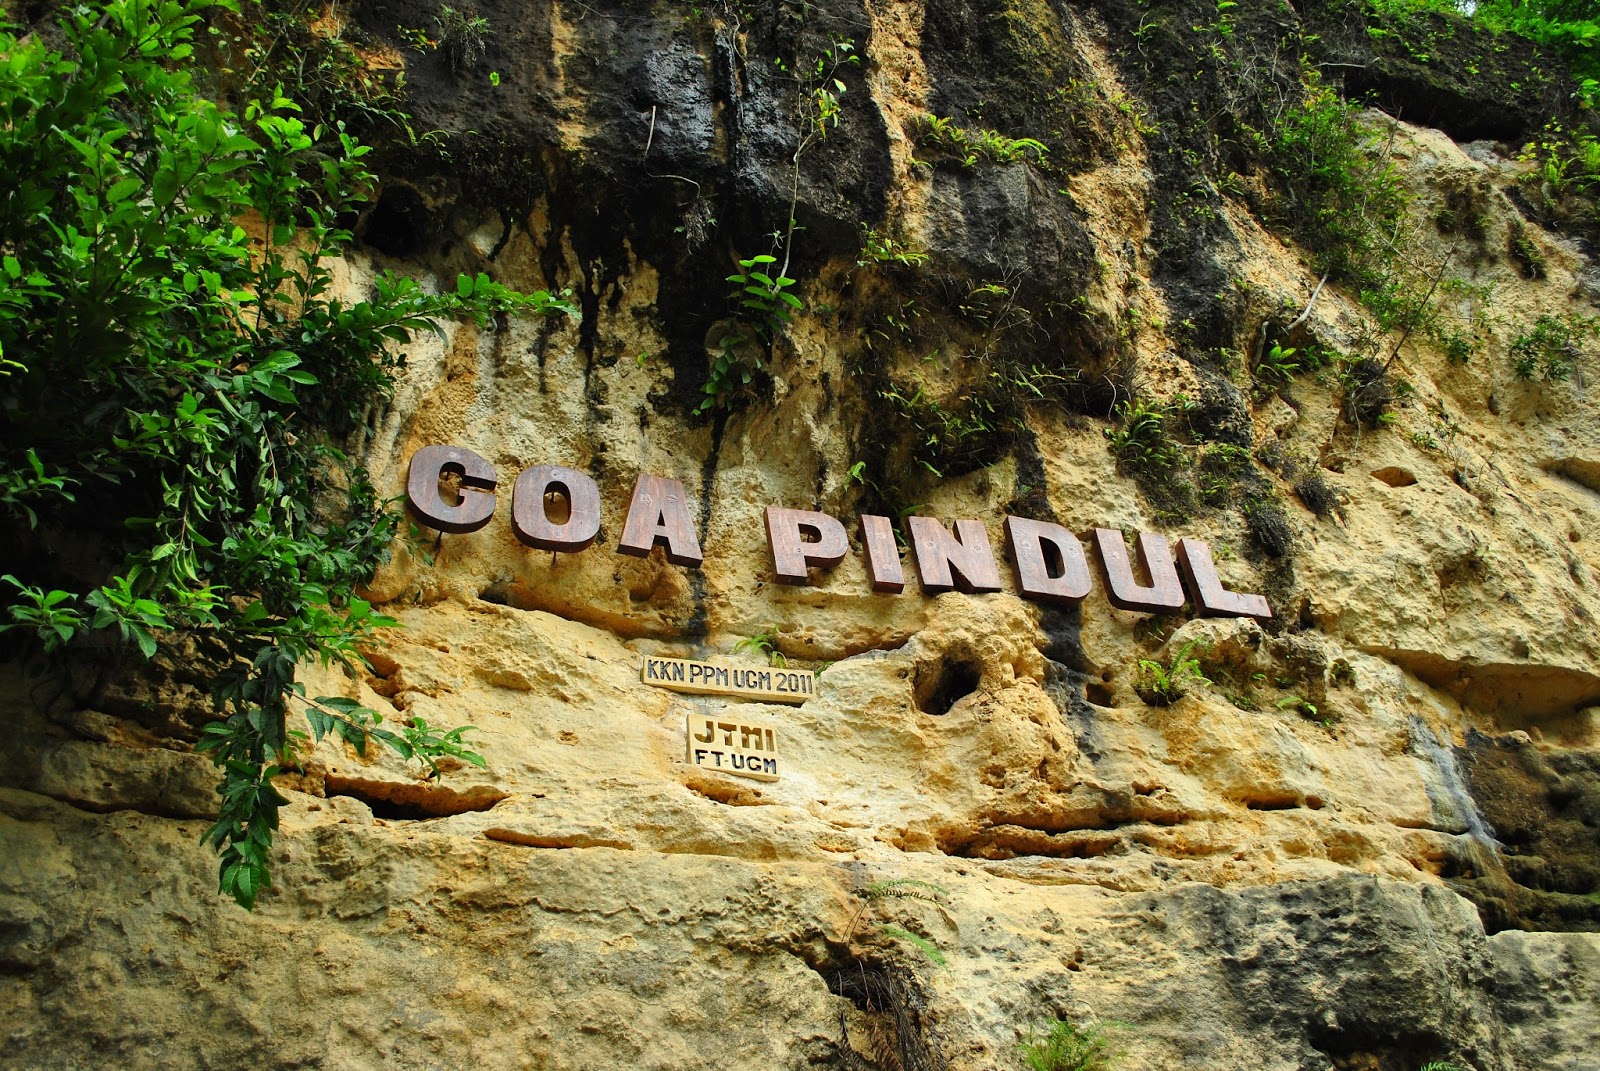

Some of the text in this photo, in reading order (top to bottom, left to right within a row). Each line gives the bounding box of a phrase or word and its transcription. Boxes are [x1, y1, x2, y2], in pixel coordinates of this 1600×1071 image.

[407, 444, 1273, 619] GOA PINDUL
[647, 659, 813, 694] KKN PPM UGM 2011
[694, 720, 775, 752] JTMI
